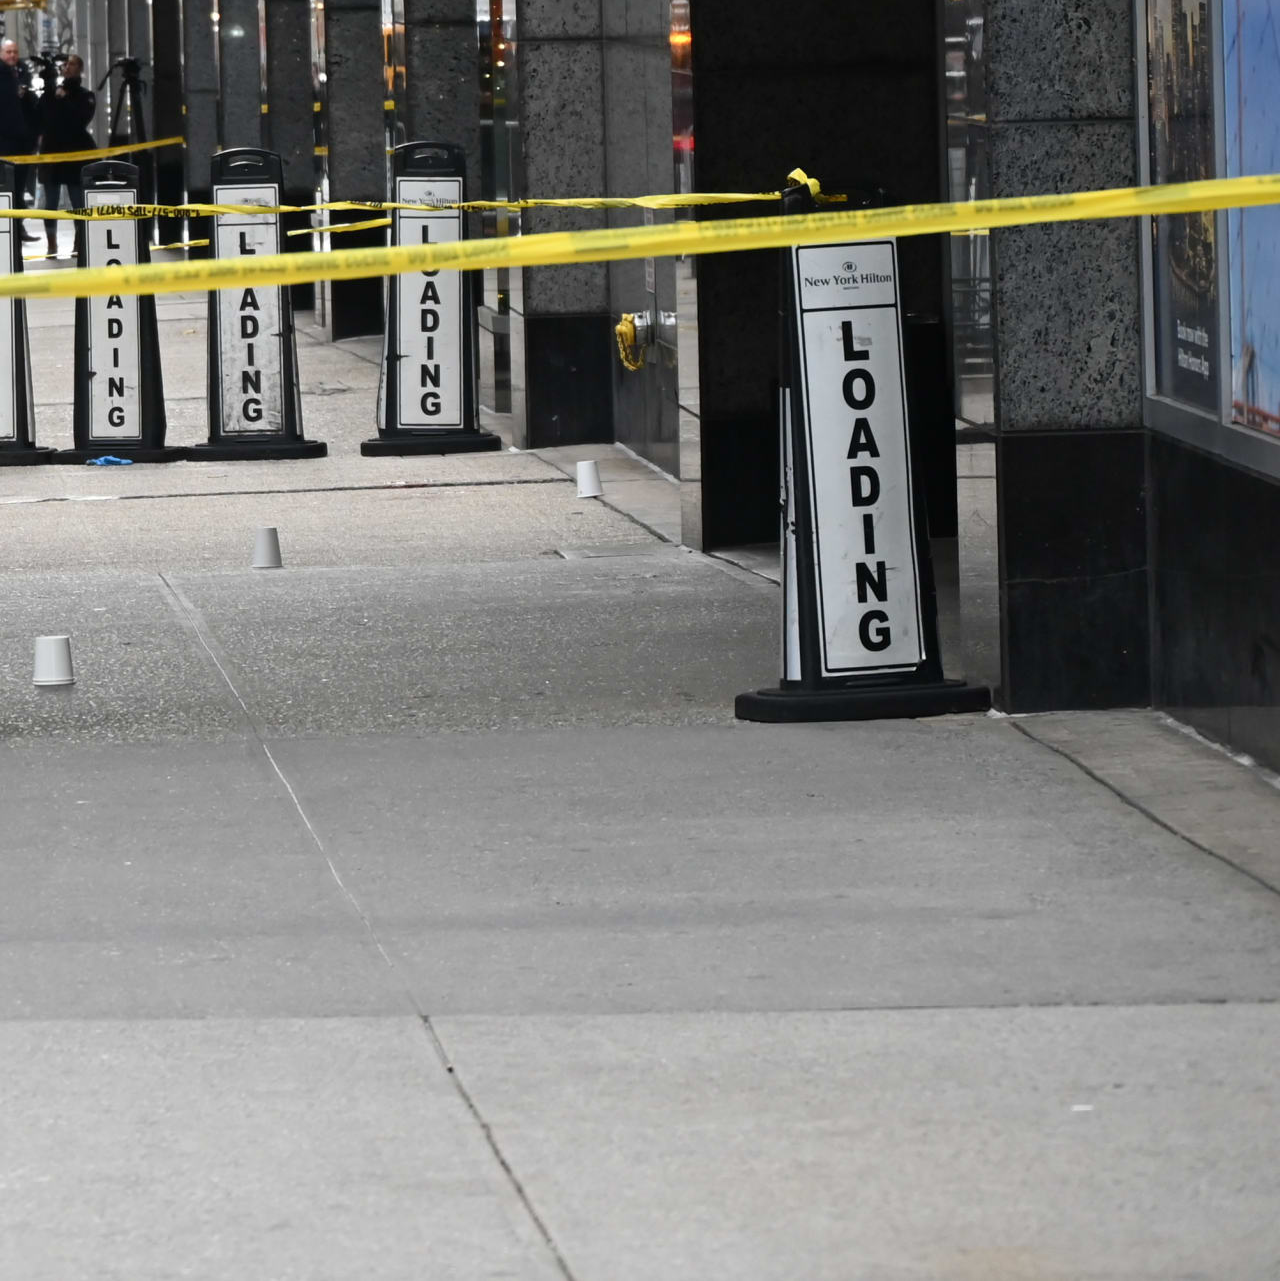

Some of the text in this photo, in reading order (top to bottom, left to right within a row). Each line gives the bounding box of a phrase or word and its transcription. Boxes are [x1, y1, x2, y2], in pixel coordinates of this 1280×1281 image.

[240, 232, 263, 422] LADING
[805, 272, 893, 288] New York Hilton
[841, 320, 892, 652] LOADING
